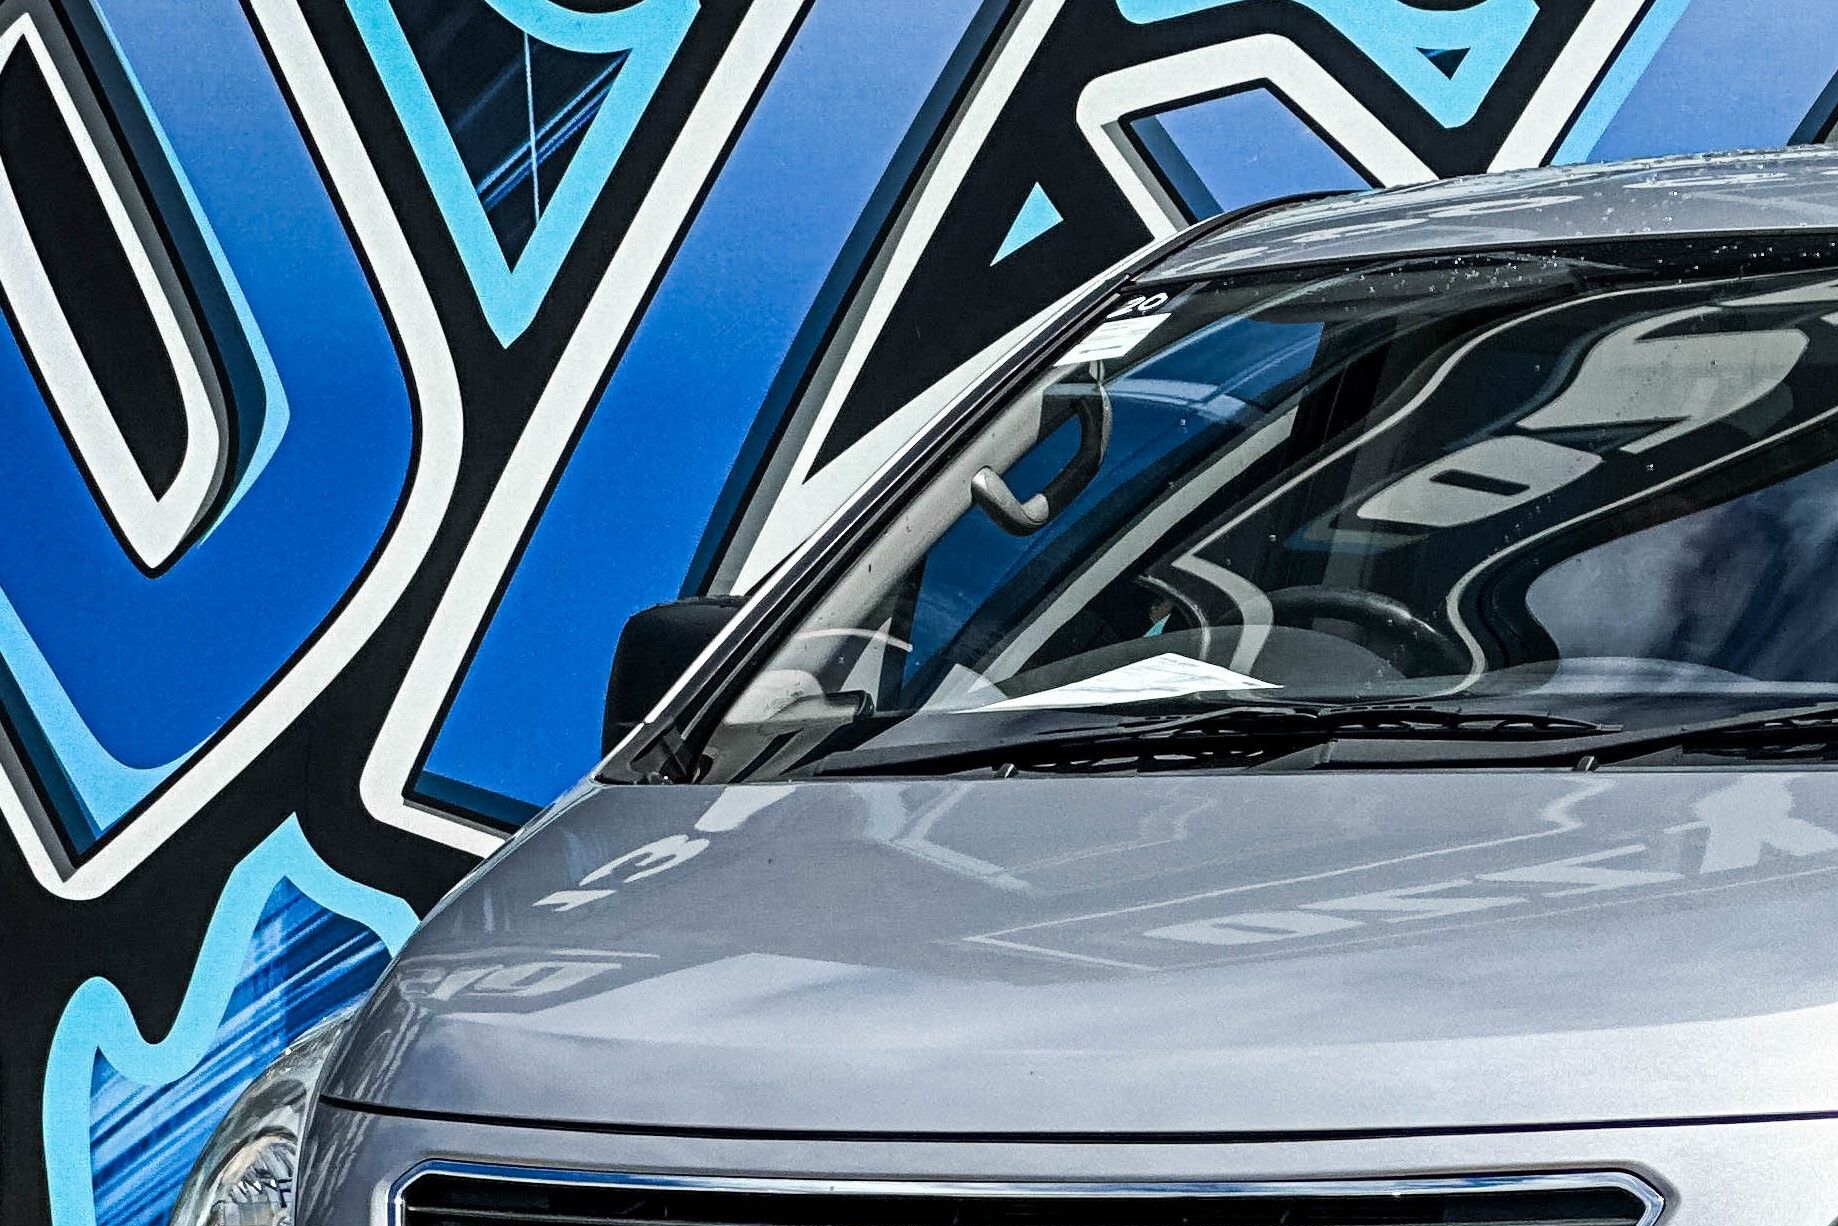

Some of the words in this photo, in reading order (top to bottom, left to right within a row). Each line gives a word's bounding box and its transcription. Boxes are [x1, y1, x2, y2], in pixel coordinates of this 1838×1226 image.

[705, 831, 773, 858] NEW
[786, 835, 885, 864] SOUTH
[903, 841, 1001, 869] WALES
